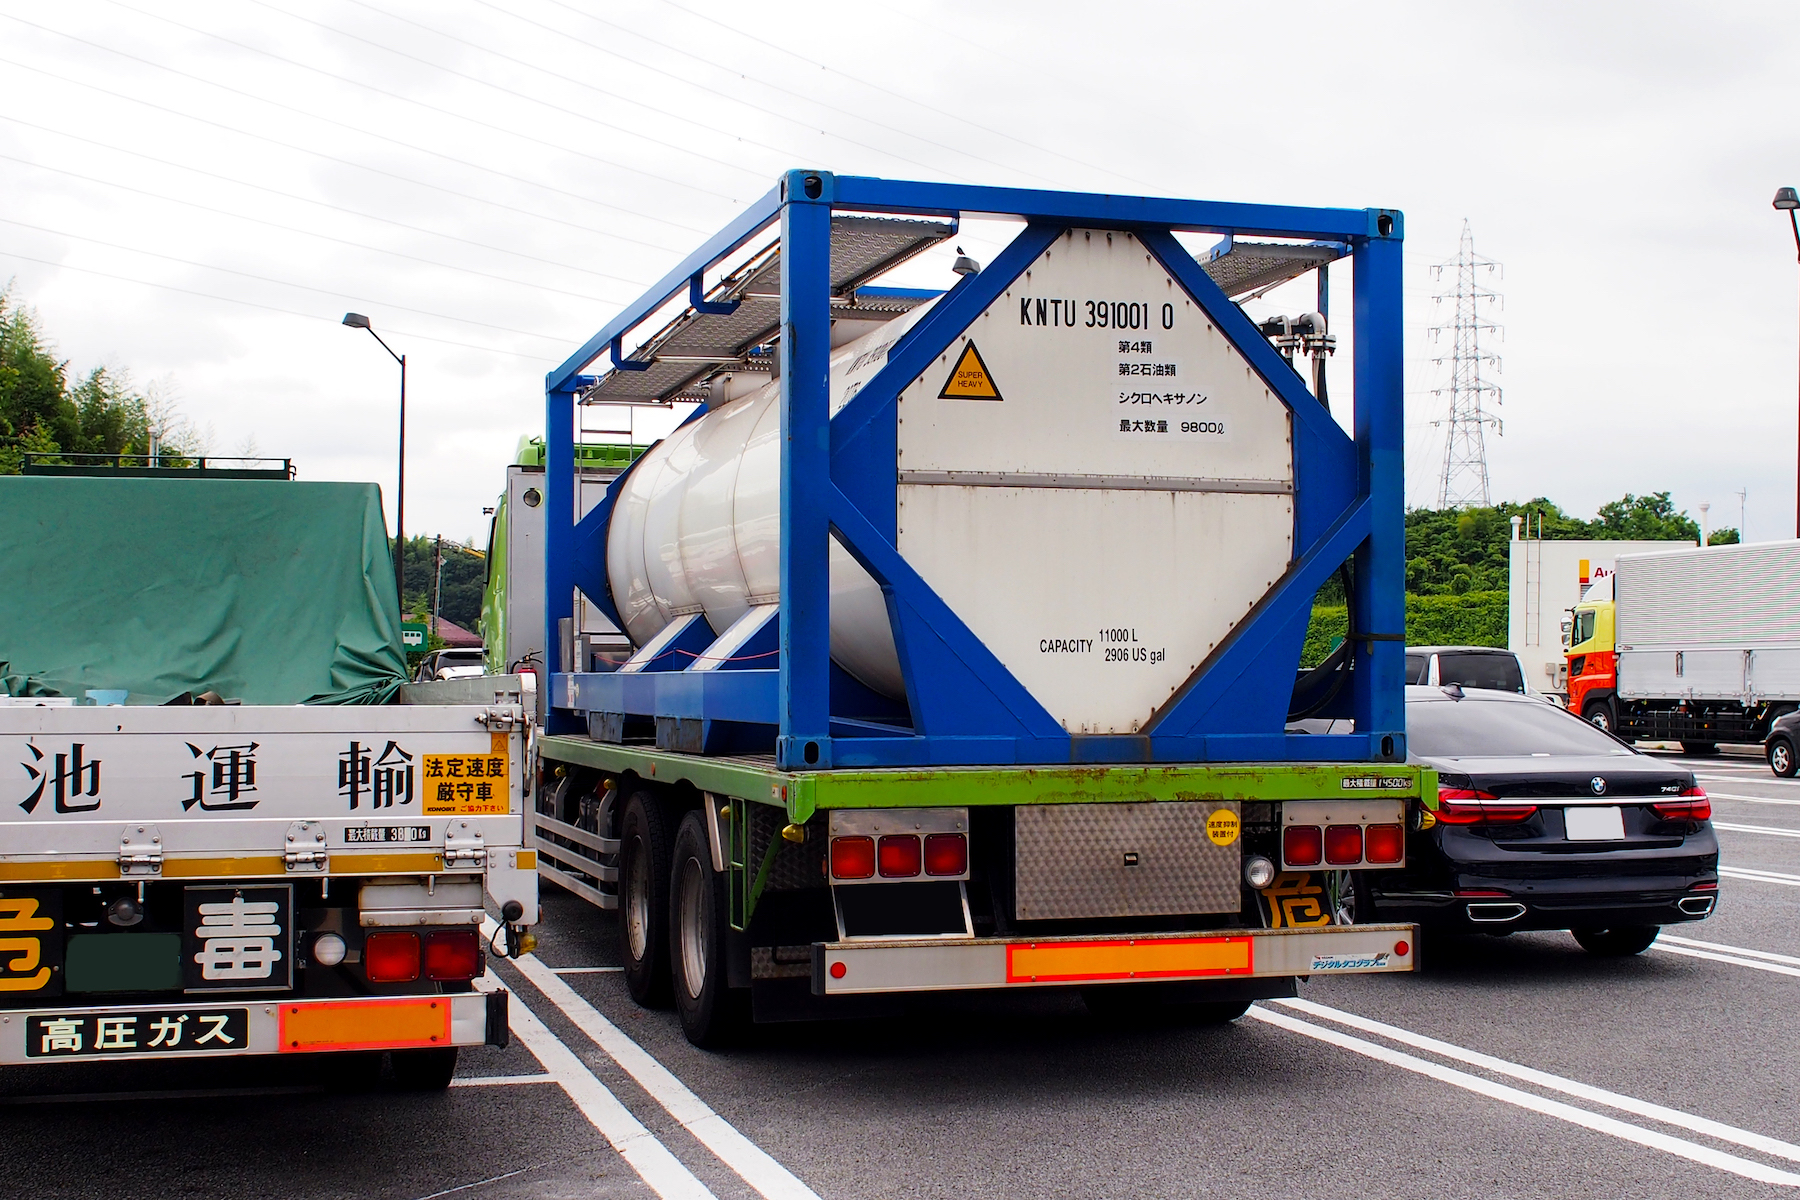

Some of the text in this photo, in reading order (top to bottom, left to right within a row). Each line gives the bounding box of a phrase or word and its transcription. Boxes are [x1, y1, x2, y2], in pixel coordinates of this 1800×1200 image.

[1020, 297, 1174, 330] KNTU 391001 0
[1118, 340, 1152, 354] 第4類
[957, 371, 983, 379] SUPER
[1118, 363, 1177, 377] 第2石油類
[957, 380, 983, 388] HEAVY
[1119, 392, 1207, 405] シクロヘキサノン
[1119, 419, 1168, 433] 最大数量
[1099, 628, 1139, 642] 11000 L
[1039, 639, 1093, 653] CAPACITY
[1104, 648, 1165, 665] 2906 US gal
[426, 757, 504, 778] 法定速度
[437, 781, 493, 802] 厳守車
[1261, 872, 1330, 929] 危
[194, 896, 282, 980] 毒
[39, 1014, 236, 1053] 高圧ガス
